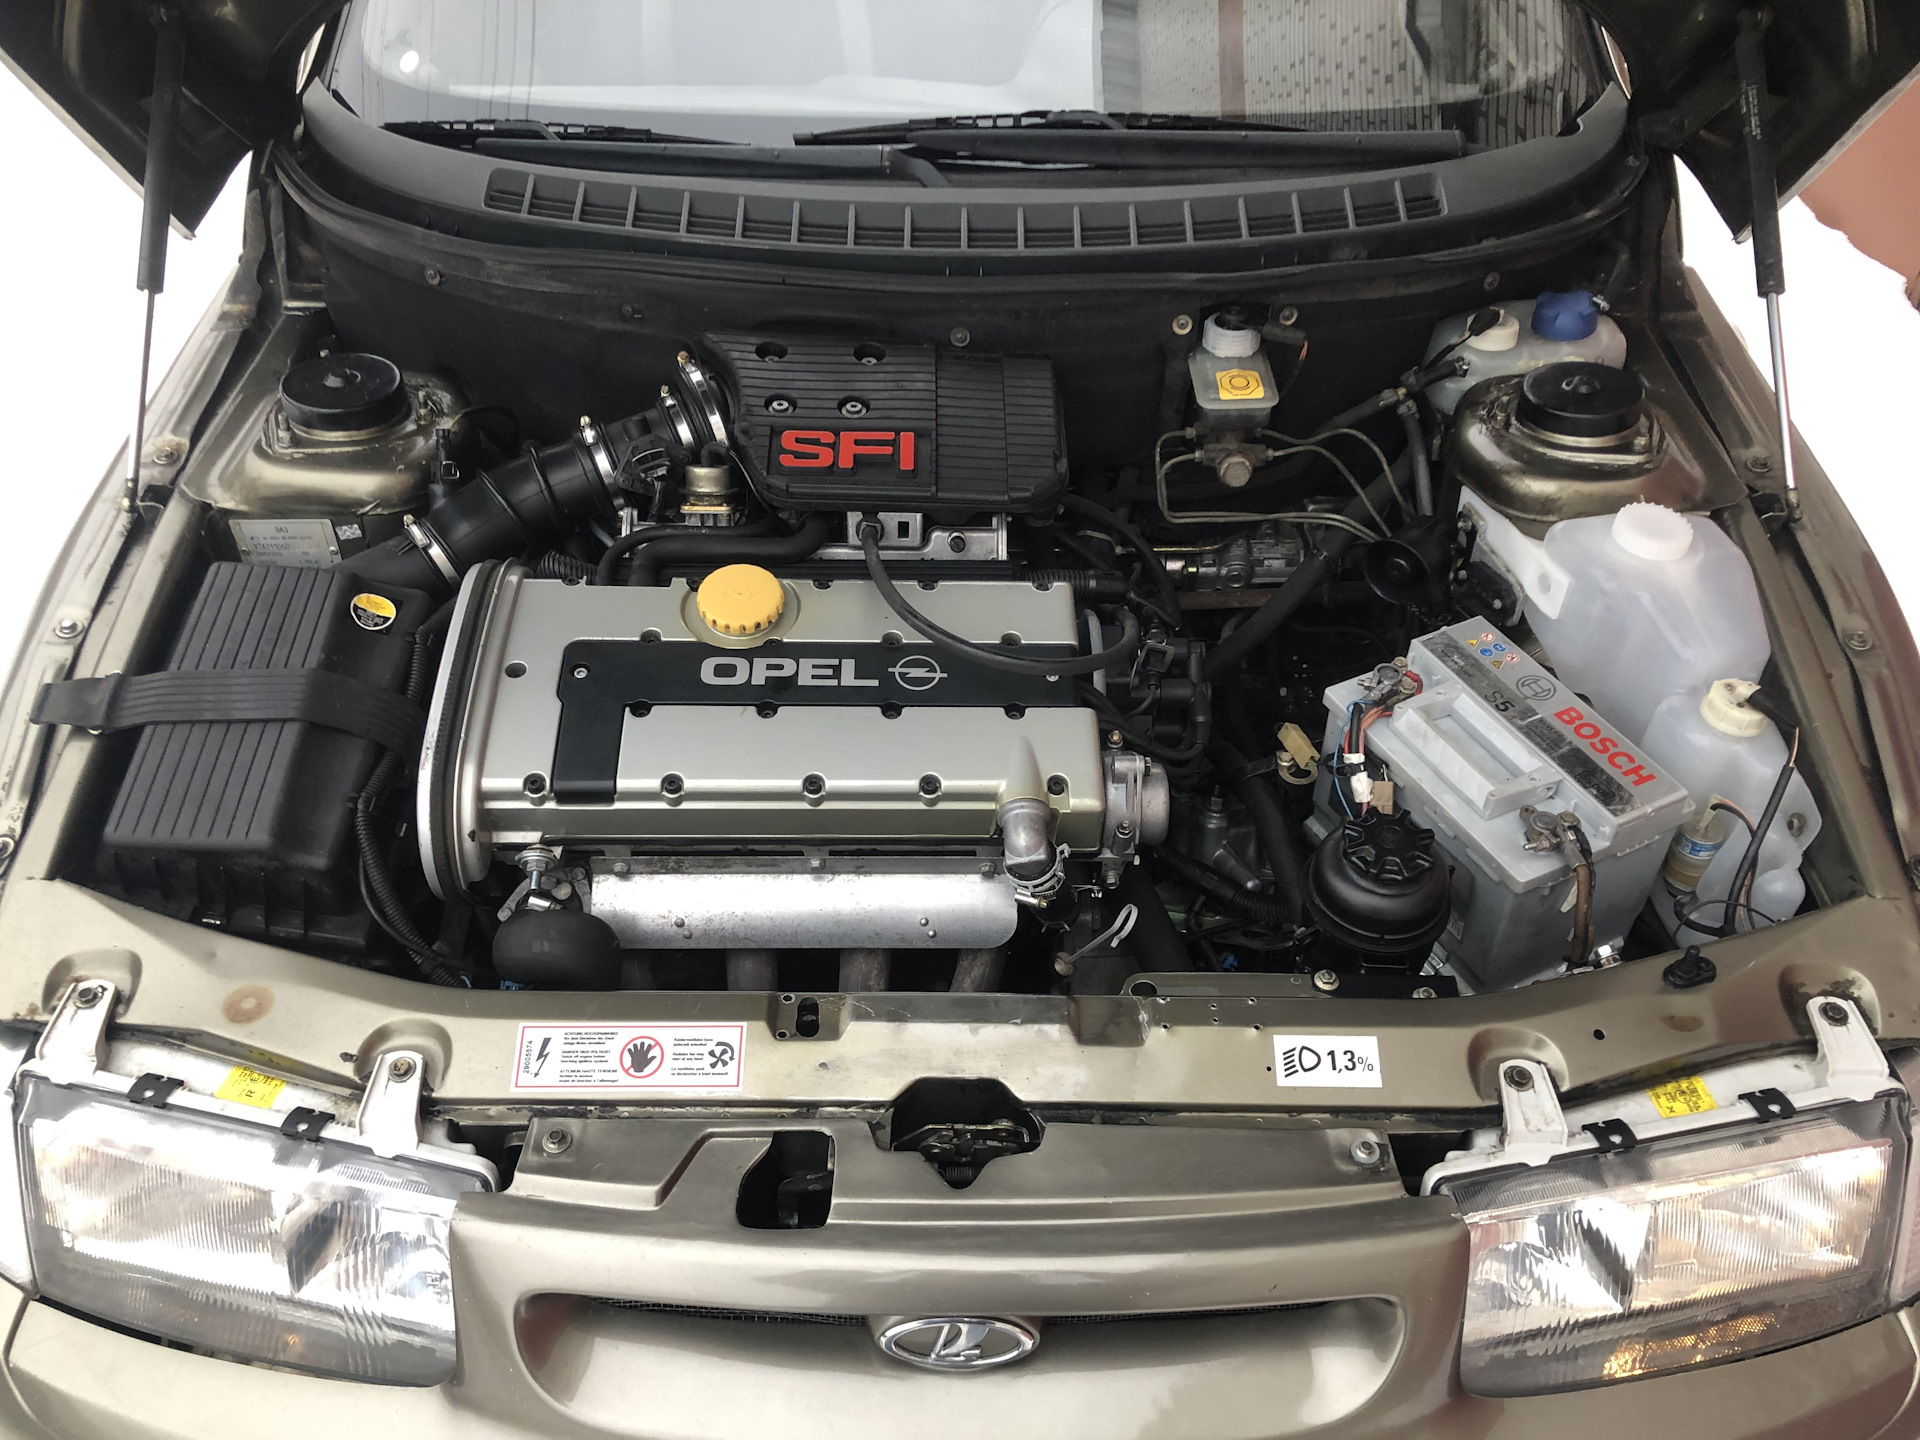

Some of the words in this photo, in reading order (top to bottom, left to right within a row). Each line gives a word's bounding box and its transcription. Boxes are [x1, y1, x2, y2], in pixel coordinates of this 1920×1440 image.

[779, 430, 915, 471] SFI
[700, 656, 880, 687] OPEL
[1553, 706, 1656, 788] BOSCH
[1326, 1050, 1374, 1074] 1,3%
